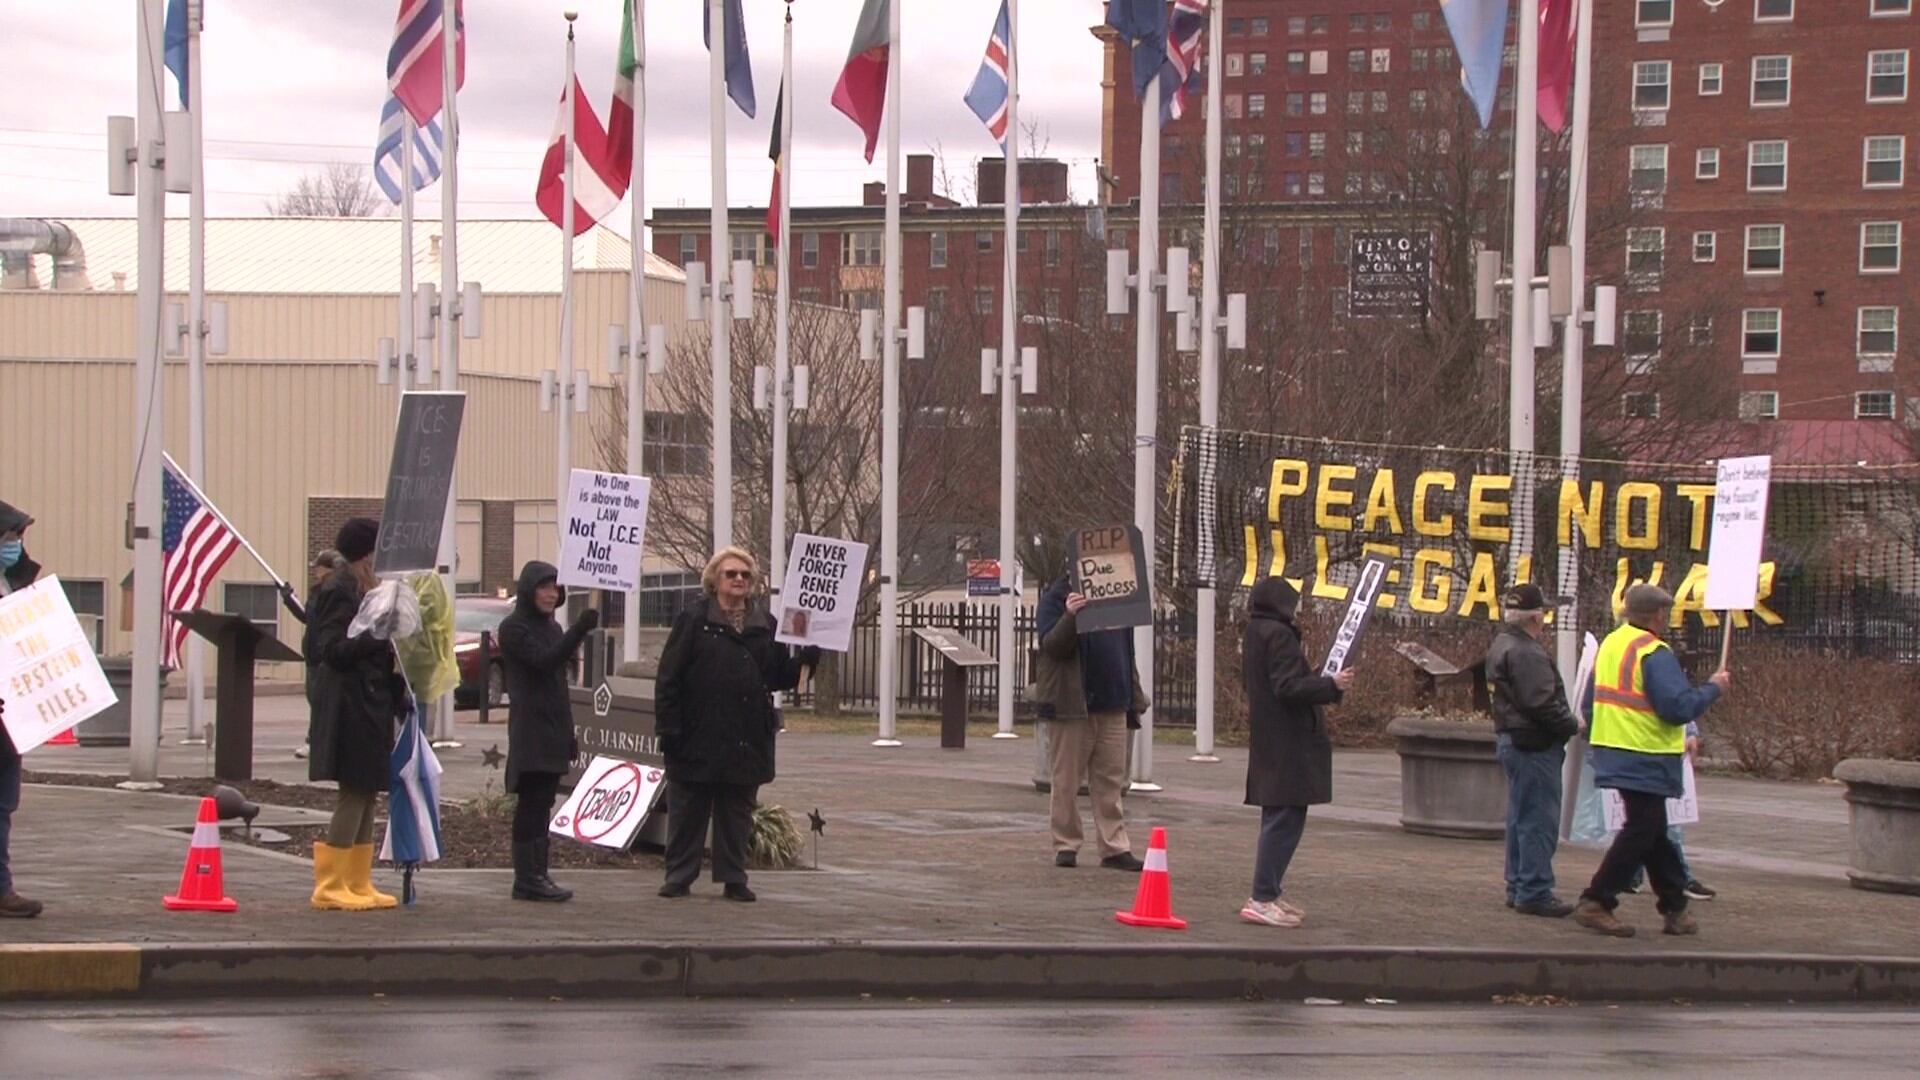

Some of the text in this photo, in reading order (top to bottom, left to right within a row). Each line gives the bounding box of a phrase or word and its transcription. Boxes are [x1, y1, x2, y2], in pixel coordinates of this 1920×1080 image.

[415, 404, 448, 434] ICE
[418, 446, 431, 467] IS
[594, 474, 630, 491] No One
[579, 488, 640, 509] is above the
[1267, 458, 1717, 551] PEACE NOT
[596, 507, 619, 522] LAW
[379, 519, 440, 552] GESTAPO
[569, 517, 640, 545] Not I.C.E.
[1081, 527, 1125, 551] RIP
[587, 540, 612, 561] Not
[805, 543, 847, 562] NEVER
[577, 557, 618, 576] Anyone
[798, 557, 848, 579] FORGET
[1081, 559, 1115, 577] Due
[800, 575, 839, 595] RENEE
[798, 592, 836, 612] GOOD
[11, 647, 82, 697] EPSTEIN
[37, 683, 88, 724] FILES
[583, 726, 595, 745] C.
[599, 728, 664, 757] MARSHAL
[581, 788, 632, 822] TRUMP
